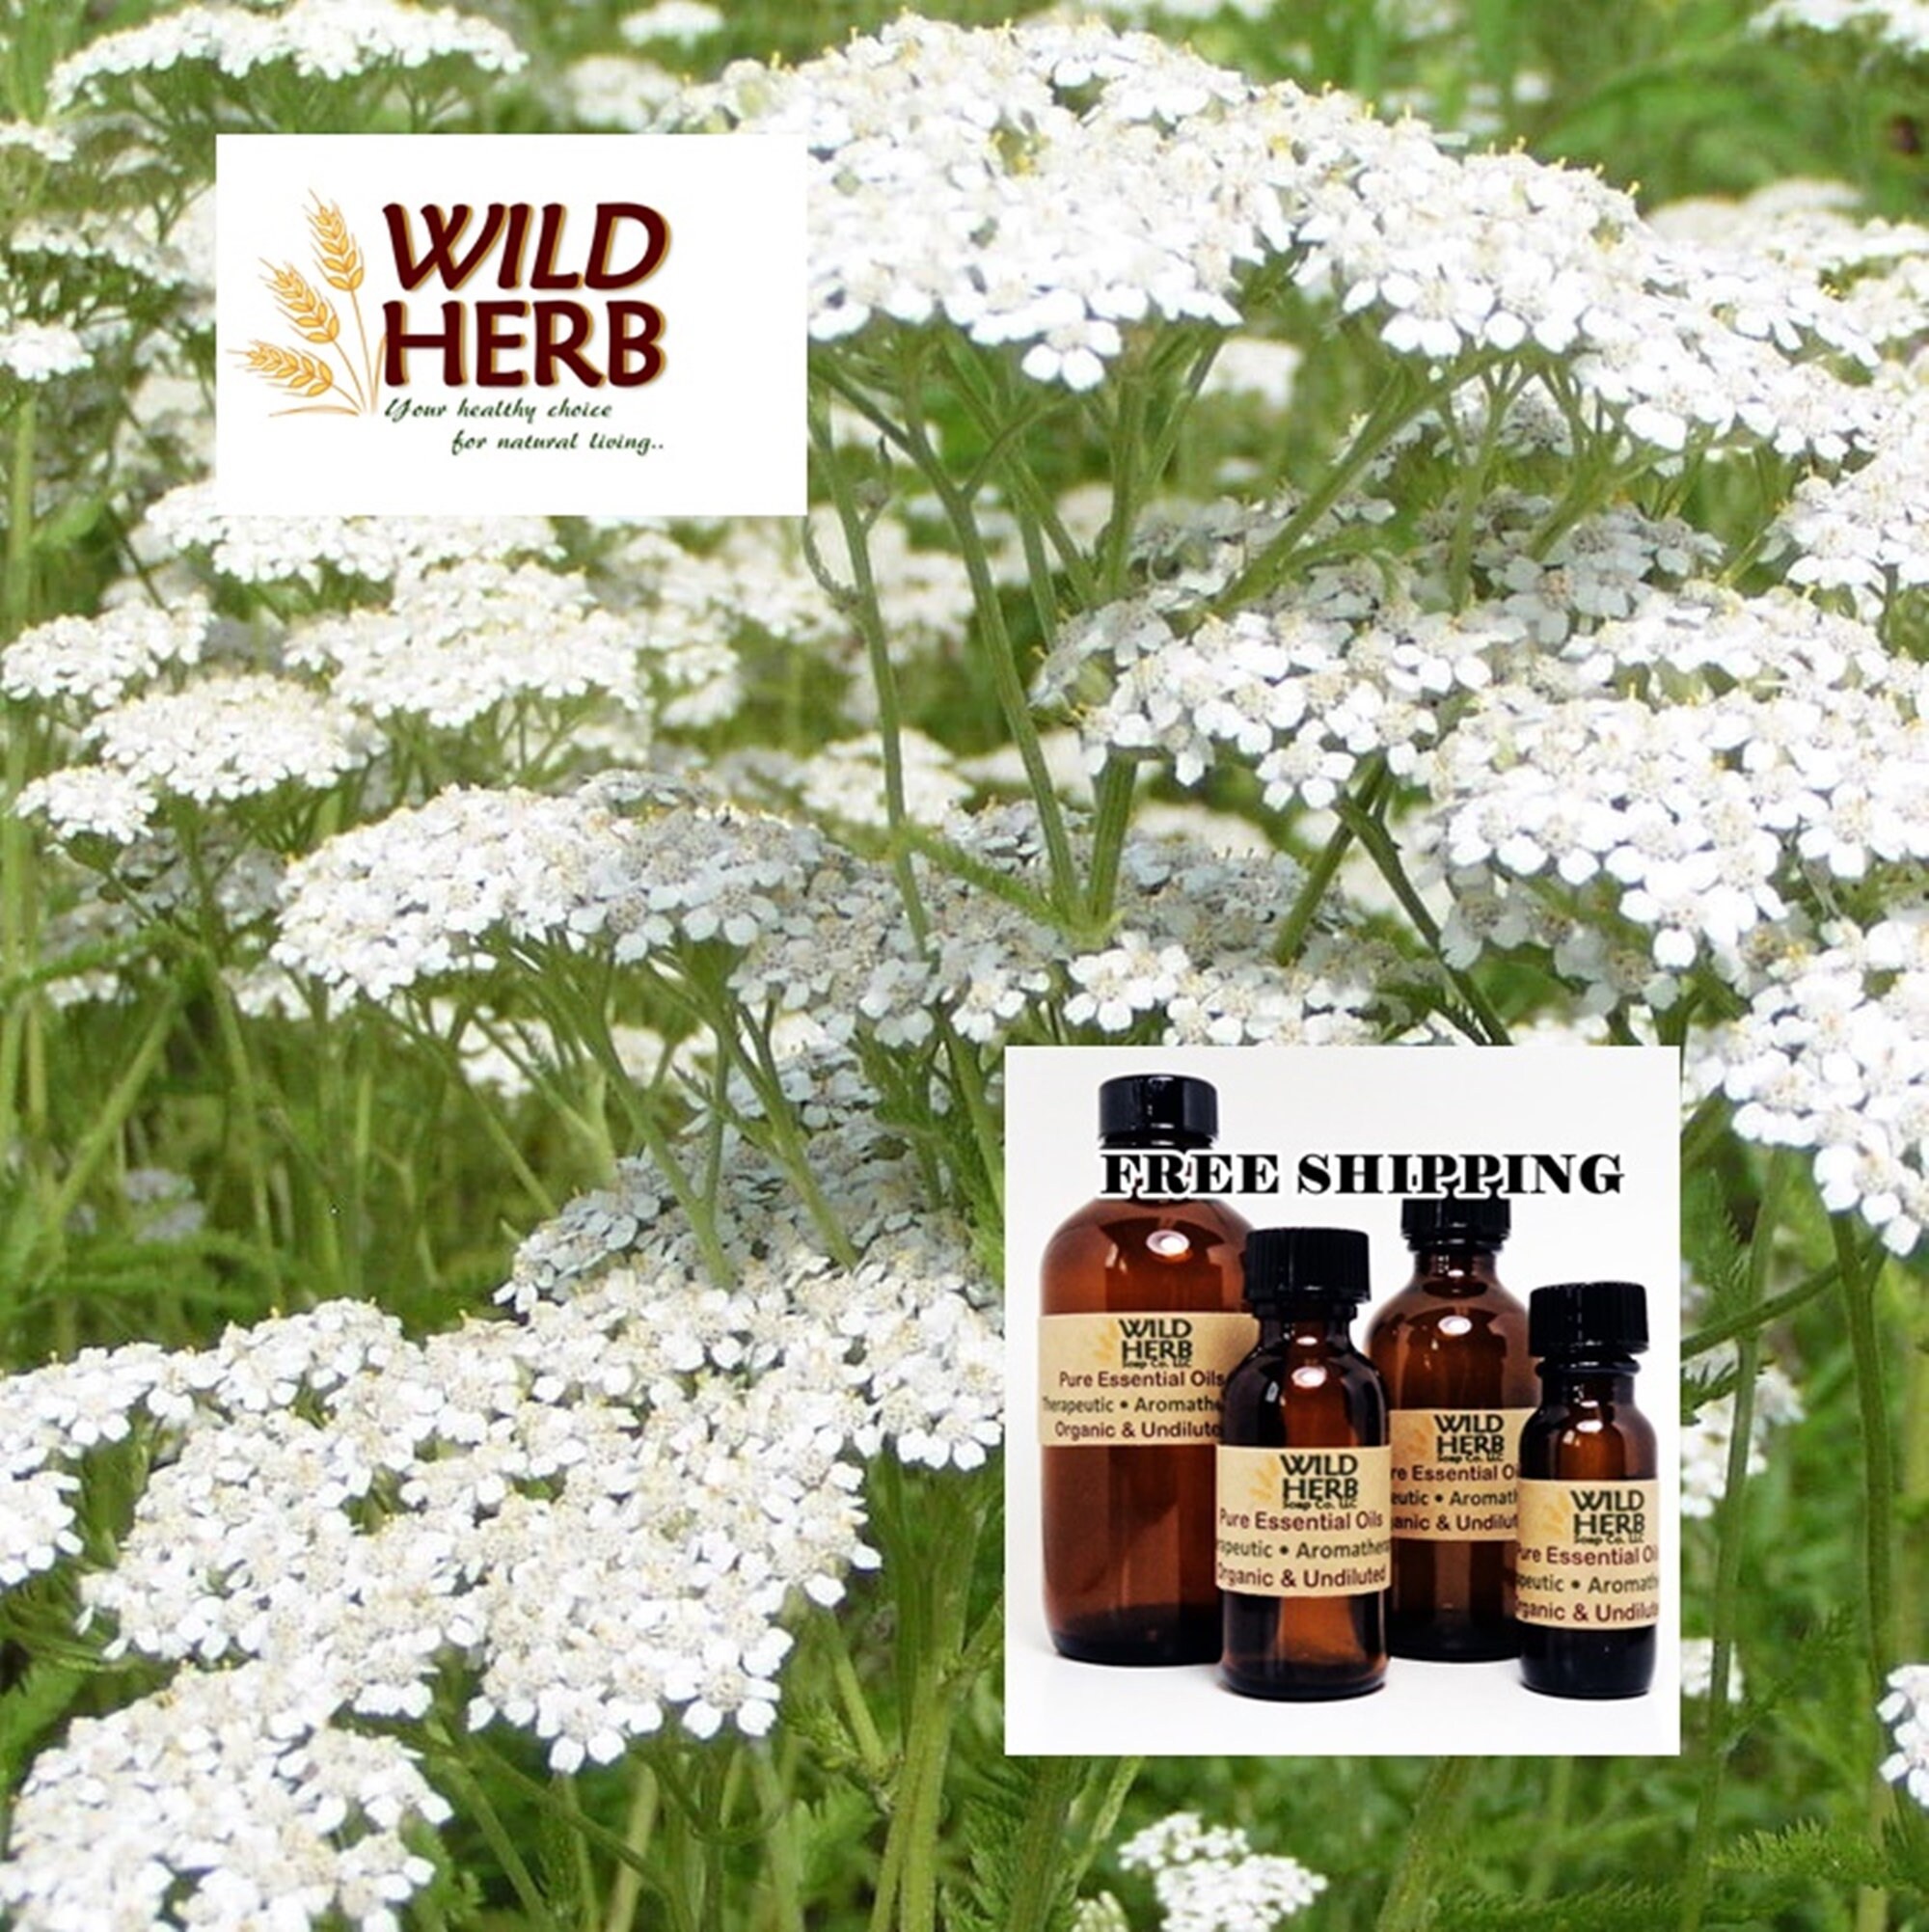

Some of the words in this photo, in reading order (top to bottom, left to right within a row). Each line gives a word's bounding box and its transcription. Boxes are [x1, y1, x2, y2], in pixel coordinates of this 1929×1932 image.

[1119, 1319, 1192, 1339] WILD
[1122, 1341, 1192, 1361] HERB
[1059, 1371, 1093, 1387] Pure
[1098, 1371, 1185, 1387] Essential
[1190, 1370, 1225, 1387] Oils
[1054, 1422, 1116, 1440] Organic
[1121, 1422, 1136, 1438] &
[1434, 1414, 1504, 1433] WILD
[1437, 1435, 1505, 1455] HERB
[1280, 1454, 1358, 1476] WILD
[1412, 1465, 1498, 1482] Essential
[1283, 1478, 1358, 1500] HERB
[1570, 1489, 1644, 1511] WILD
[1220, 1508, 1250, 1529] Pure
[1255, 1511, 1350, 1531] Essential
[1356, 1510, 1383, 1529] Oils
[1436, 1514, 1451, 1531] &
[1573, 1513, 1645, 1536] HERB
[1546, 1546, 1640, 1565] Essential
[1281, 1569, 1296, 1588] &
[1303, 1565, 1386, 1588] Undiluted
[1573, 1603, 1589, 1621] &
